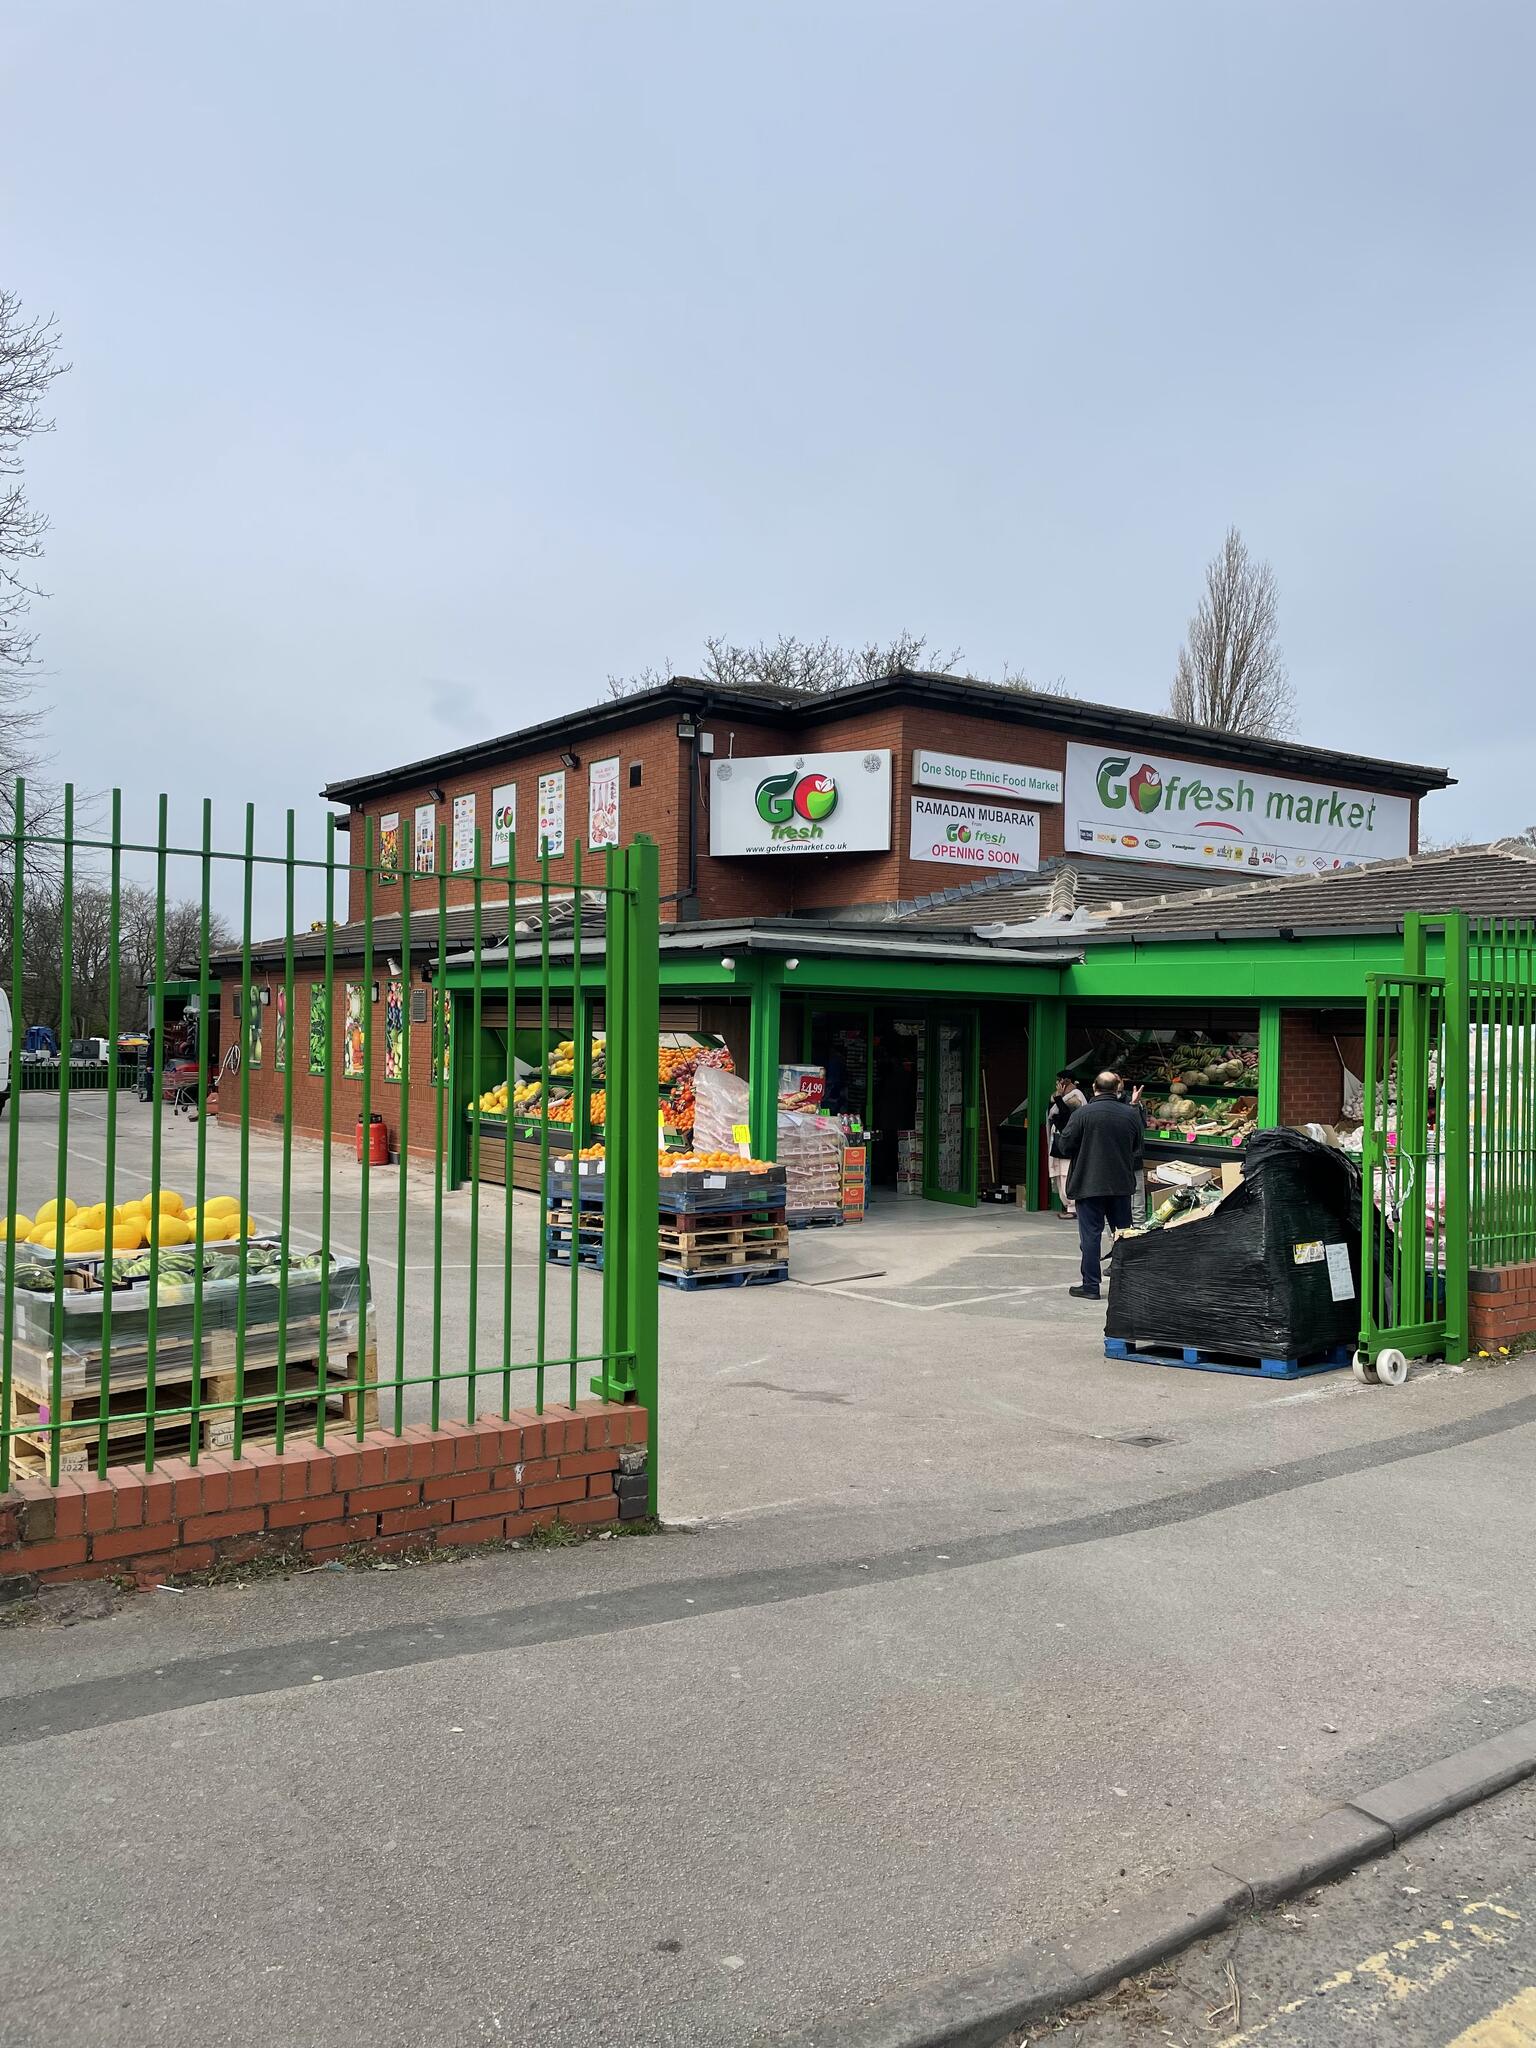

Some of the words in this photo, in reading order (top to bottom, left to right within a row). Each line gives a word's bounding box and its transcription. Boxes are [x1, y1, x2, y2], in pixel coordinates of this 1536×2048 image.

[921, 762, 941, 775] One
[944, 765, 967, 780] Stop
[970, 769, 1000, 784] Ethnic
[1003, 774, 1026, 787] Food
[1029, 778, 1059, 792] Market
[755, 770, 839, 824] GO
[1165, 776, 1255, 812] fresh
[1266, 791, 1376, 831] market
[916, 800, 975, 819] RAMADAN
[978, 808, 1034, 827] MUBARAK
[495, 831, 510, 842] fres
[771, 823, 823, 840] fresh
[946, 823, 971, 843] GO
[974, 830, 1006, 844] fresh
[745, 842, 847, 854] www.gofreshmarket.co.uk
[932, 844, 984, 860] OPENING
[988, 850, 1019, 864] SOON
[801, 1081, 823, 1097] £4.99
